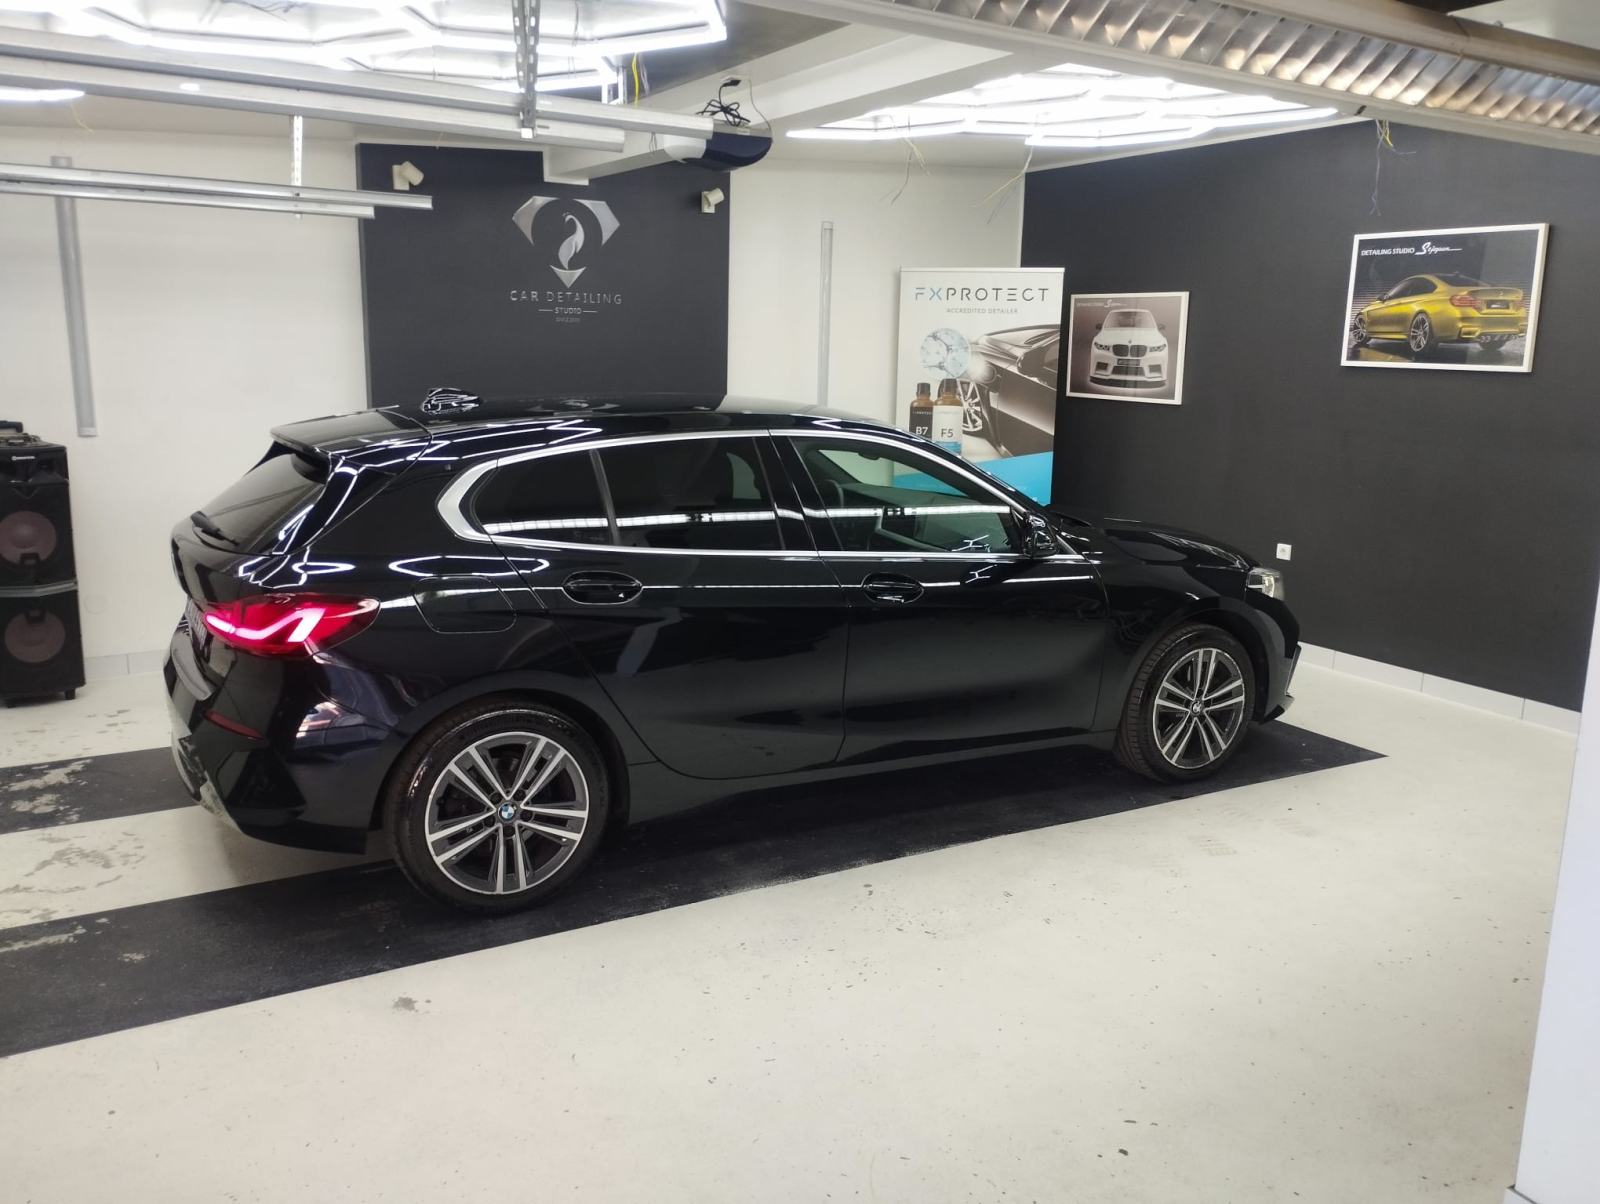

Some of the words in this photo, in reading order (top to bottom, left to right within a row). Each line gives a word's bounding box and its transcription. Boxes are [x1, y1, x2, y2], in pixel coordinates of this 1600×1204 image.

[1361, 247, 1392, 256] DETAILING
[1392, 247, 1415, 255] STUDIO
[509, 290, 539, 302] CAR
[546, 291, 622, 305] DETAILING
[914, 287, 1049, 302] FXPROTECT
[554, 307, 582, 315] STUDIO
[915, 426, 928, 436] B7
[941, 428, 954, 438] F5
